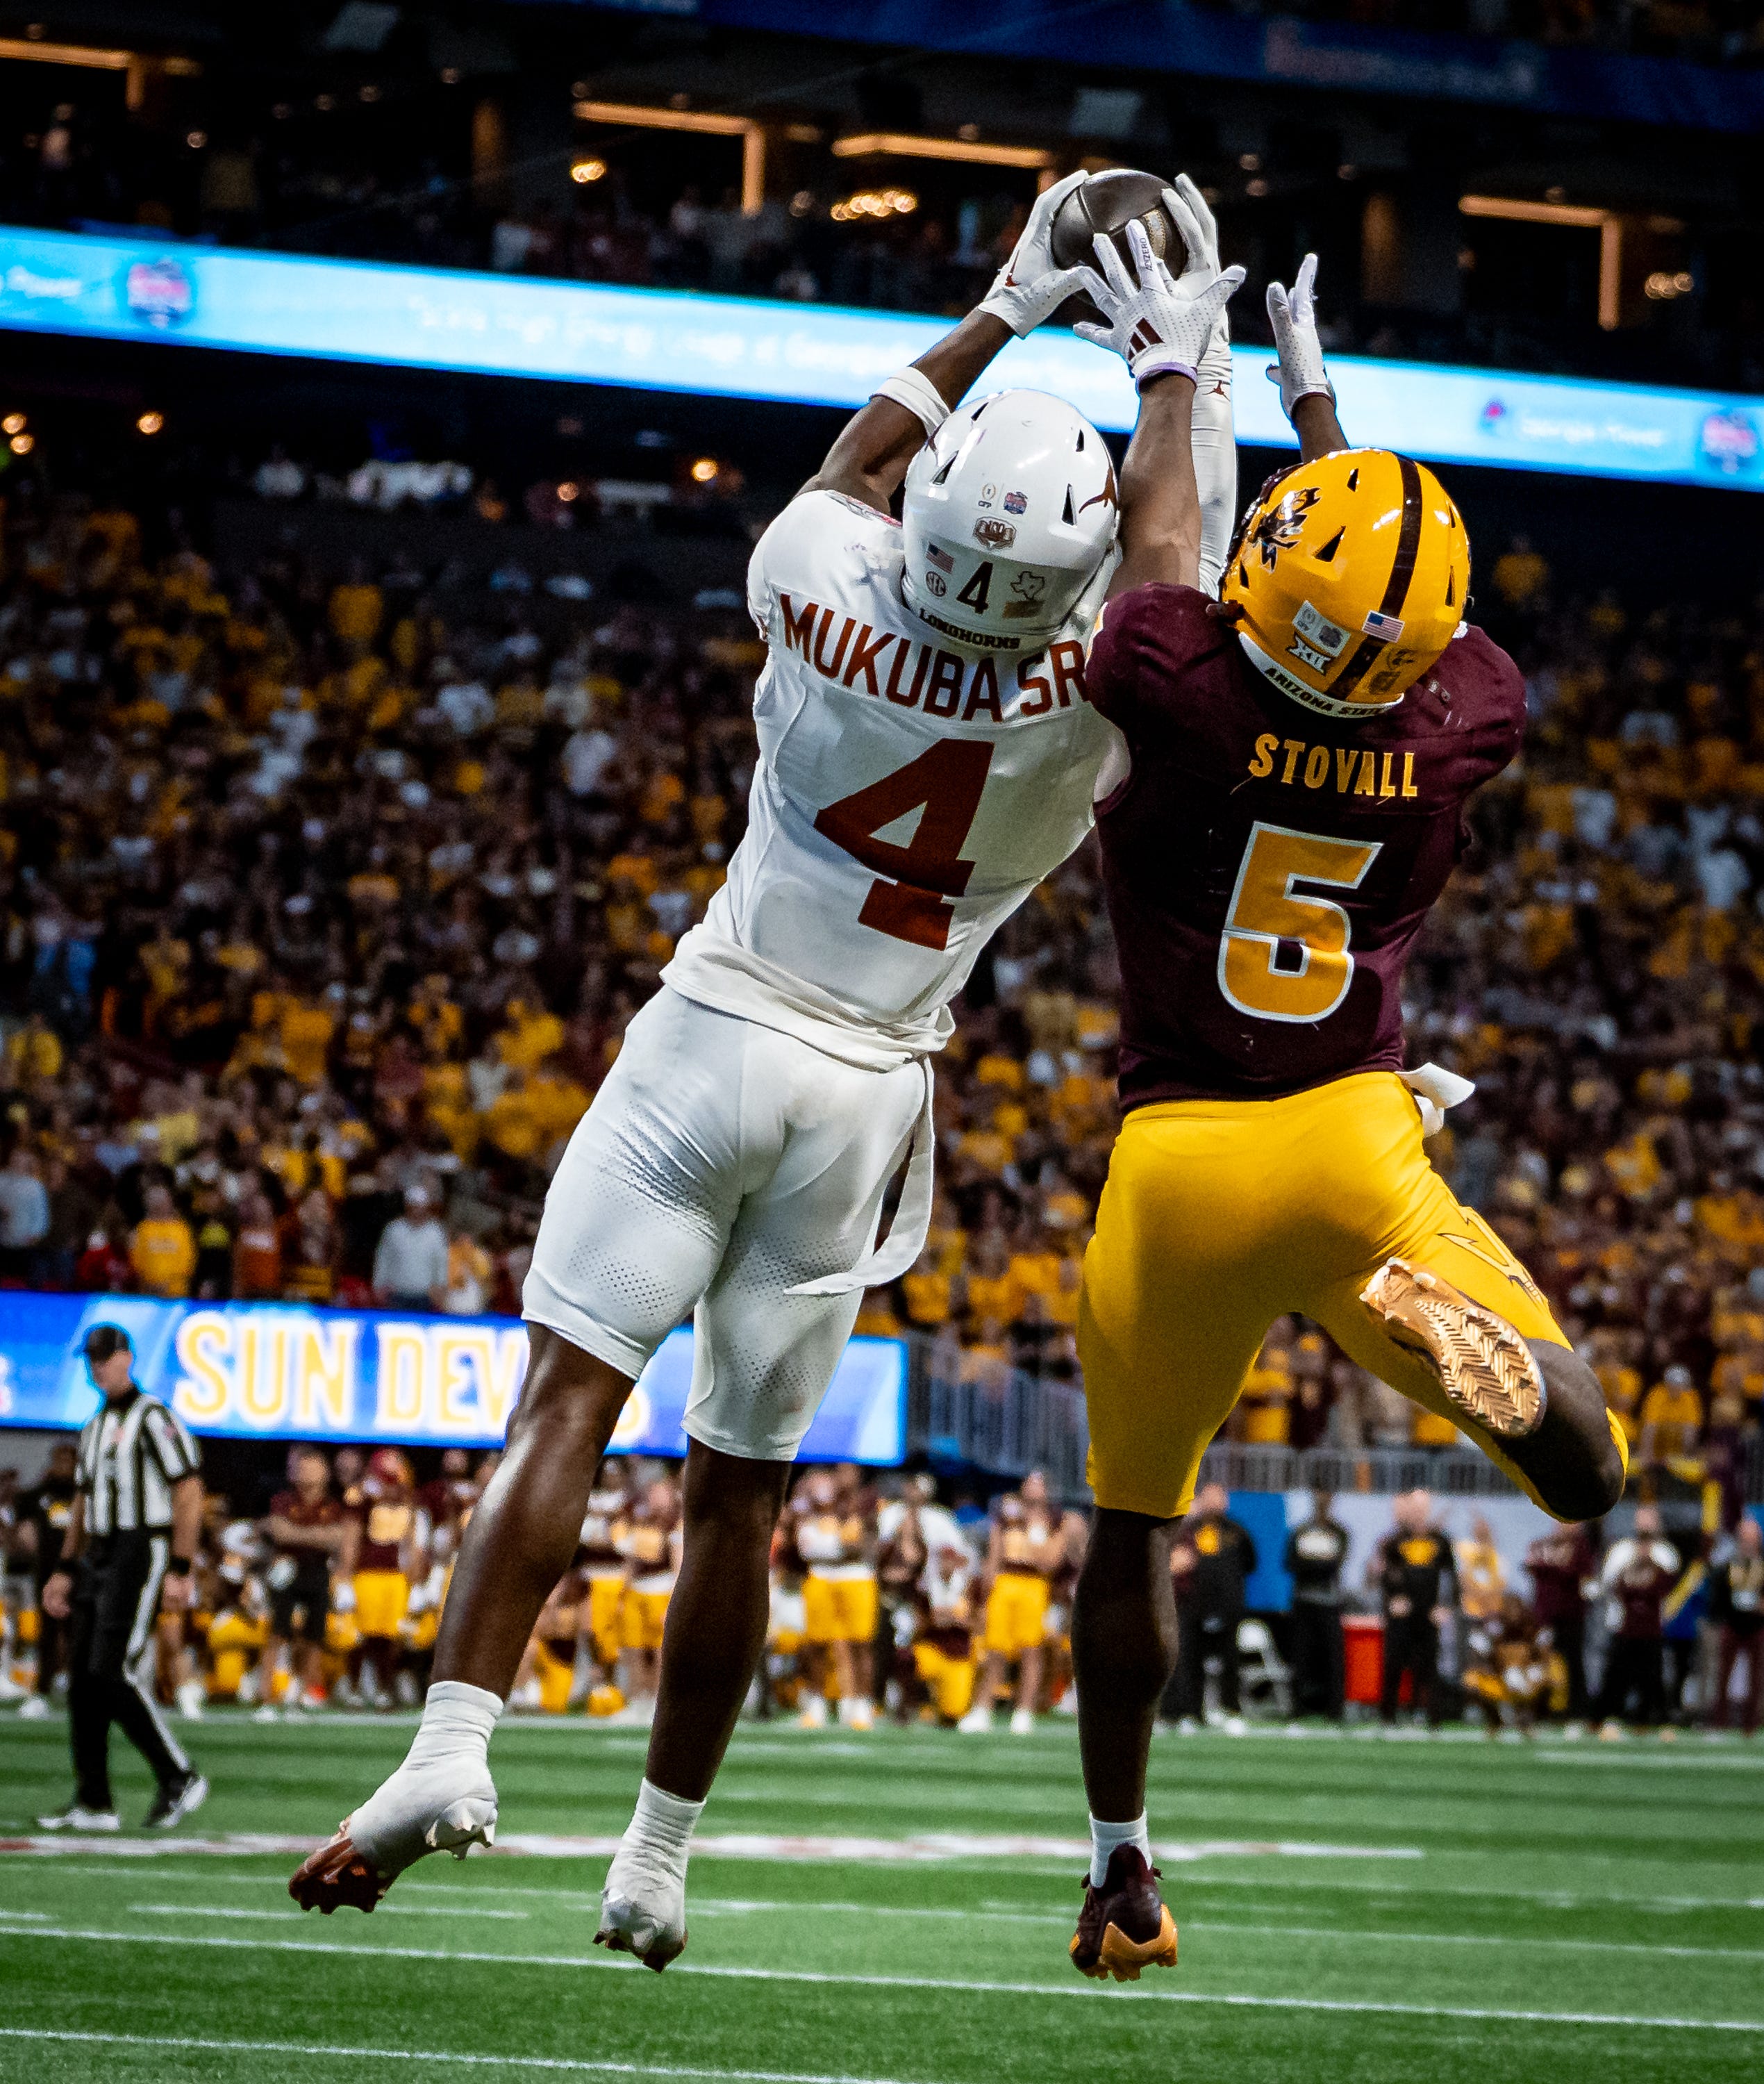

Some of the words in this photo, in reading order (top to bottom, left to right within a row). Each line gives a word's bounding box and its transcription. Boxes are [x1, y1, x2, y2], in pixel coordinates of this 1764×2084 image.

[918, 608, 1021, 650] LONGHORNS
[956, 561, 993, 615] 4
[779, 593, 1004, 722] MUKUBA
[1017, 639, 1091, 717] SR
[1264, 668, 1334, 711] ARIZONA
[1248, 734, 1418, 797] STOVALL
[813, 738, 995, 952] 4
[1217, 820, 1384, 1023] 5
[174, 1310, 360, 1428] SUN
[374, 1320, 651, 1445] DEV
